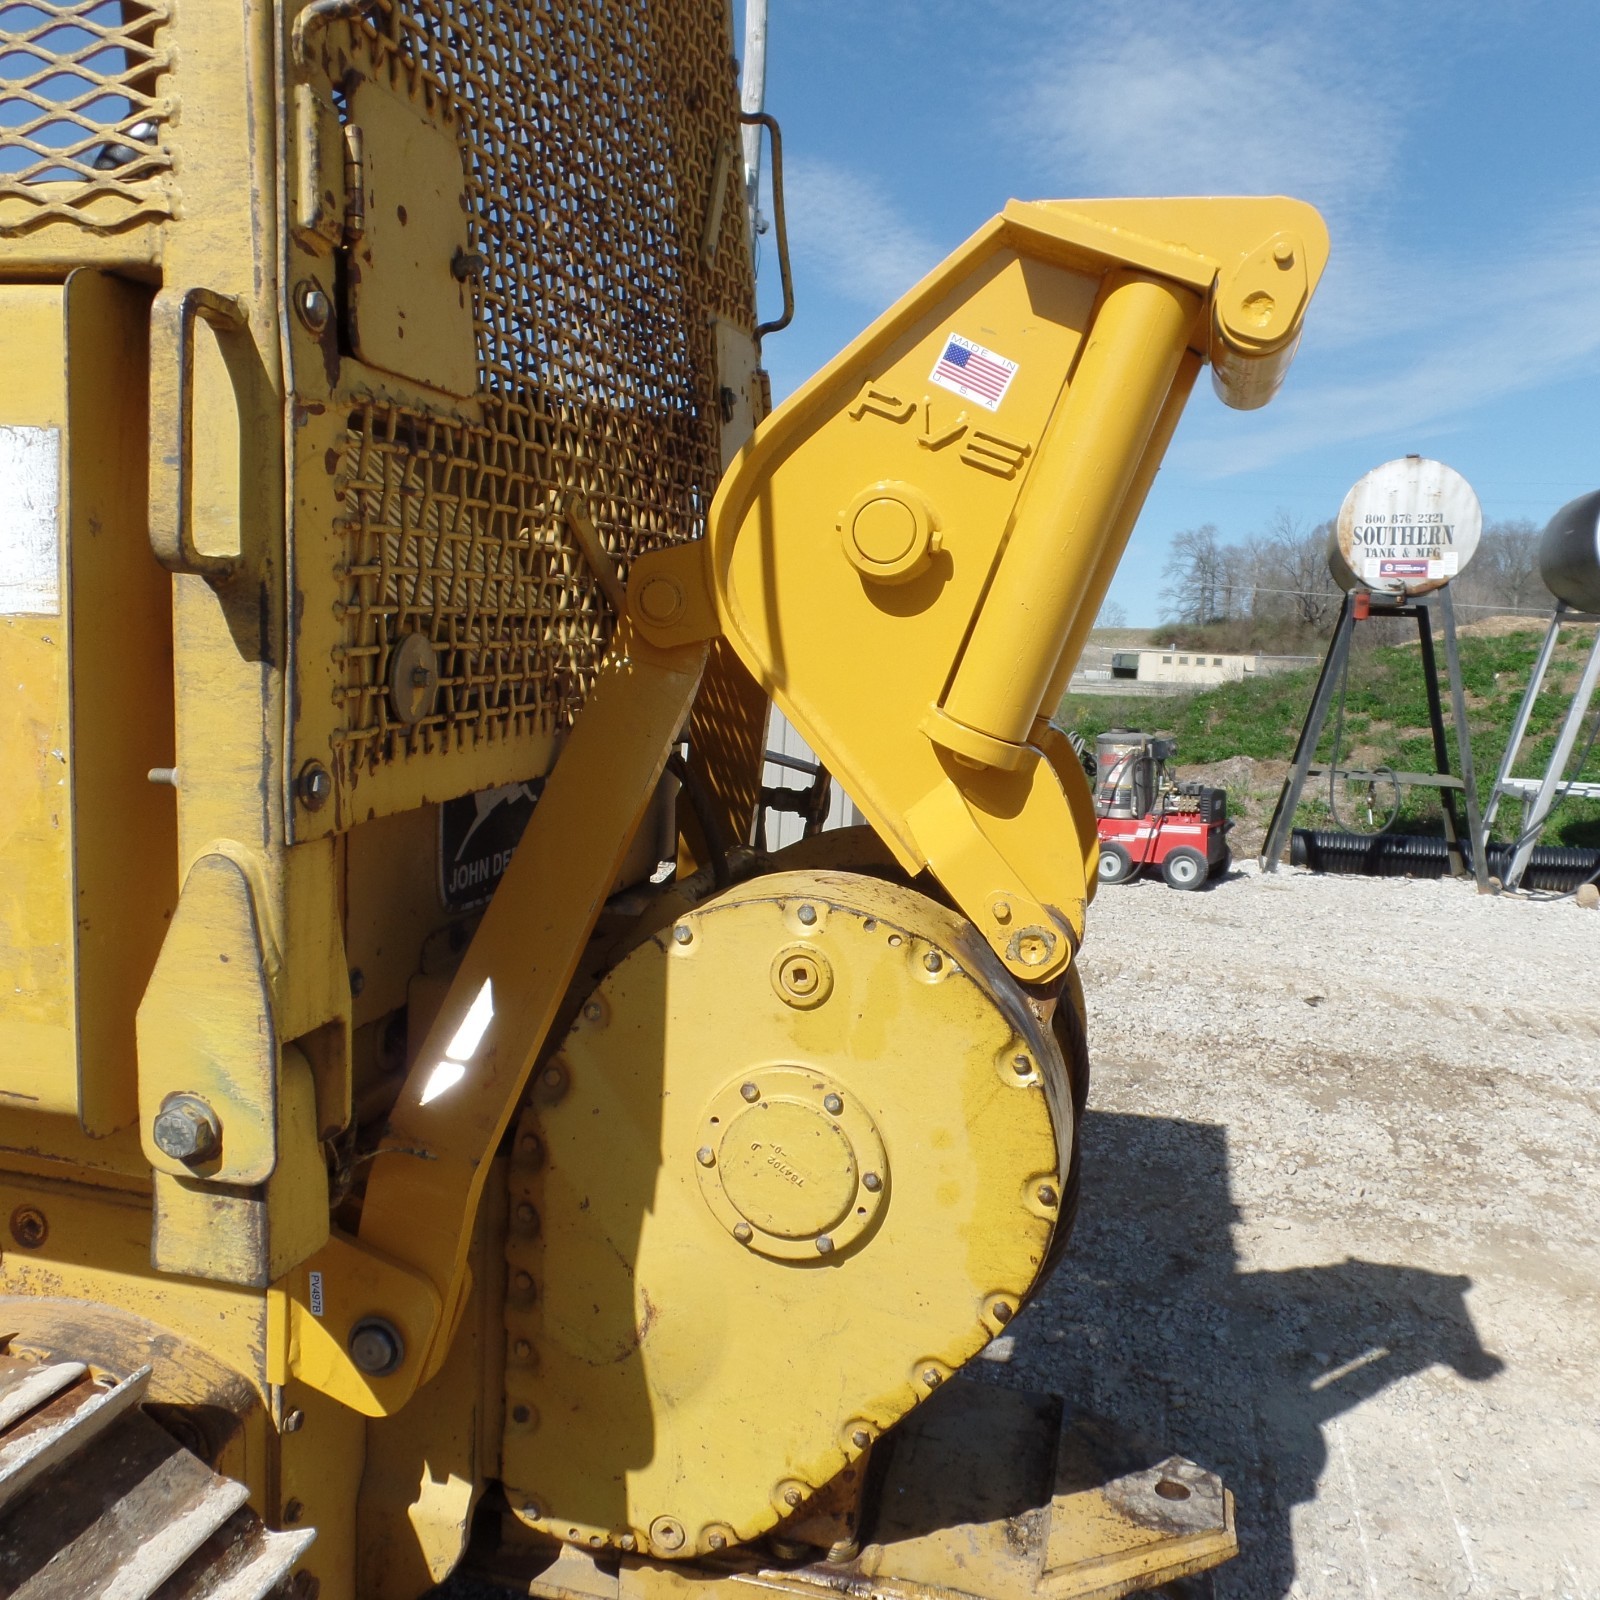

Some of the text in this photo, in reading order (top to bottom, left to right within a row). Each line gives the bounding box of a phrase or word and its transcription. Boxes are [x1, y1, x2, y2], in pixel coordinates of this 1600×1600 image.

[950, 334, 1016, 371] MADE IN
[848, 380, 1032, 482] PVE
[1352, 524, 1455, 546] SOUTHERN
[1365, 512, 1444, 524] 800 876 2321
[1364, 547, 1441, 558] TANK & MFG
[449, 857, 490, 893] JOHN
[311, 1274, 321, 1313] PV497B
